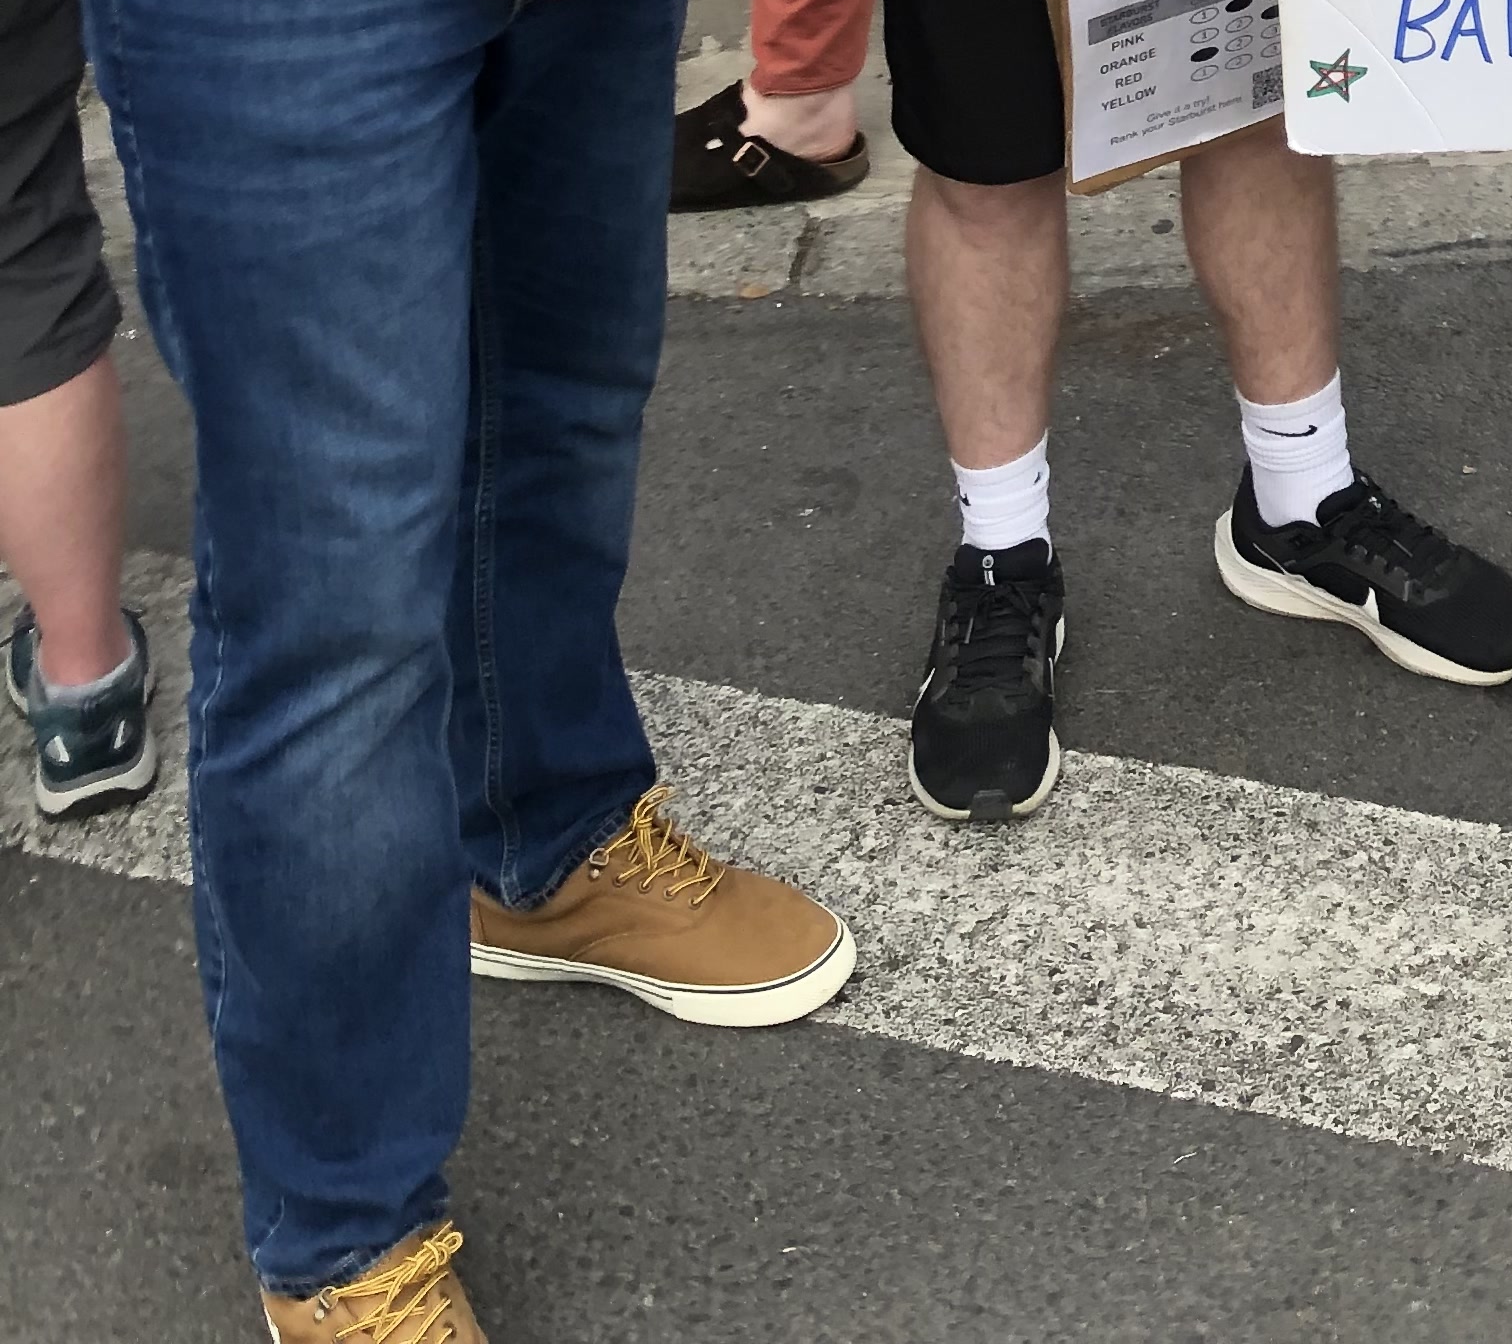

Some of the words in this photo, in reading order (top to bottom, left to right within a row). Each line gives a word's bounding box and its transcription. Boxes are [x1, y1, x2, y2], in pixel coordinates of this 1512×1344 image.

[1111, 32, 1145, 52] PINK
[1099, 47, 1157, 76] ORANGE
[1115, 71, 1143, 89] RED
[1101, 85, 1158, 112] YELLOW
